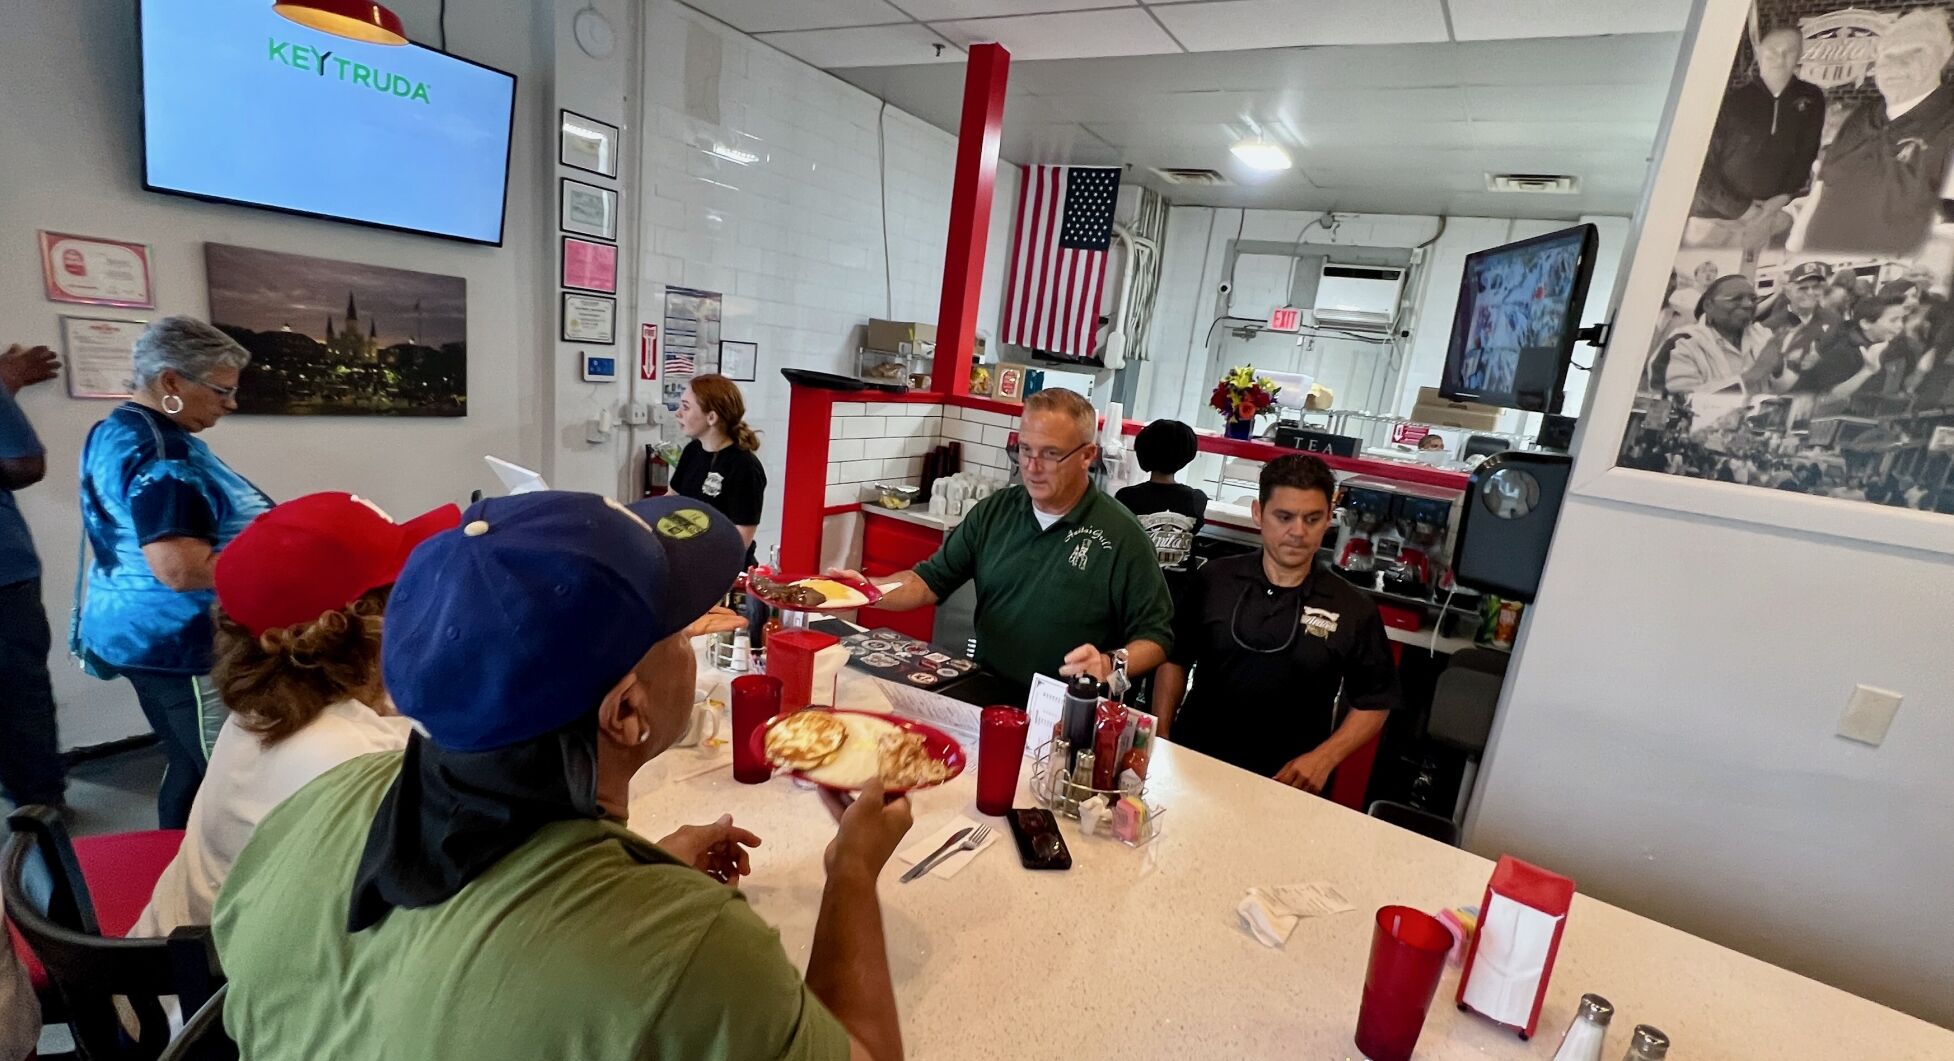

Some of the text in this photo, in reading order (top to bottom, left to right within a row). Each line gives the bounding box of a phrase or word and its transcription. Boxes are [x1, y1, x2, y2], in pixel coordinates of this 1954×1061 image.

[268, 37, 430, 104] KEYTRUDA
[1271, 310, 1298, 330] EXIT
[1294, 437, 1333, 455] TEA
